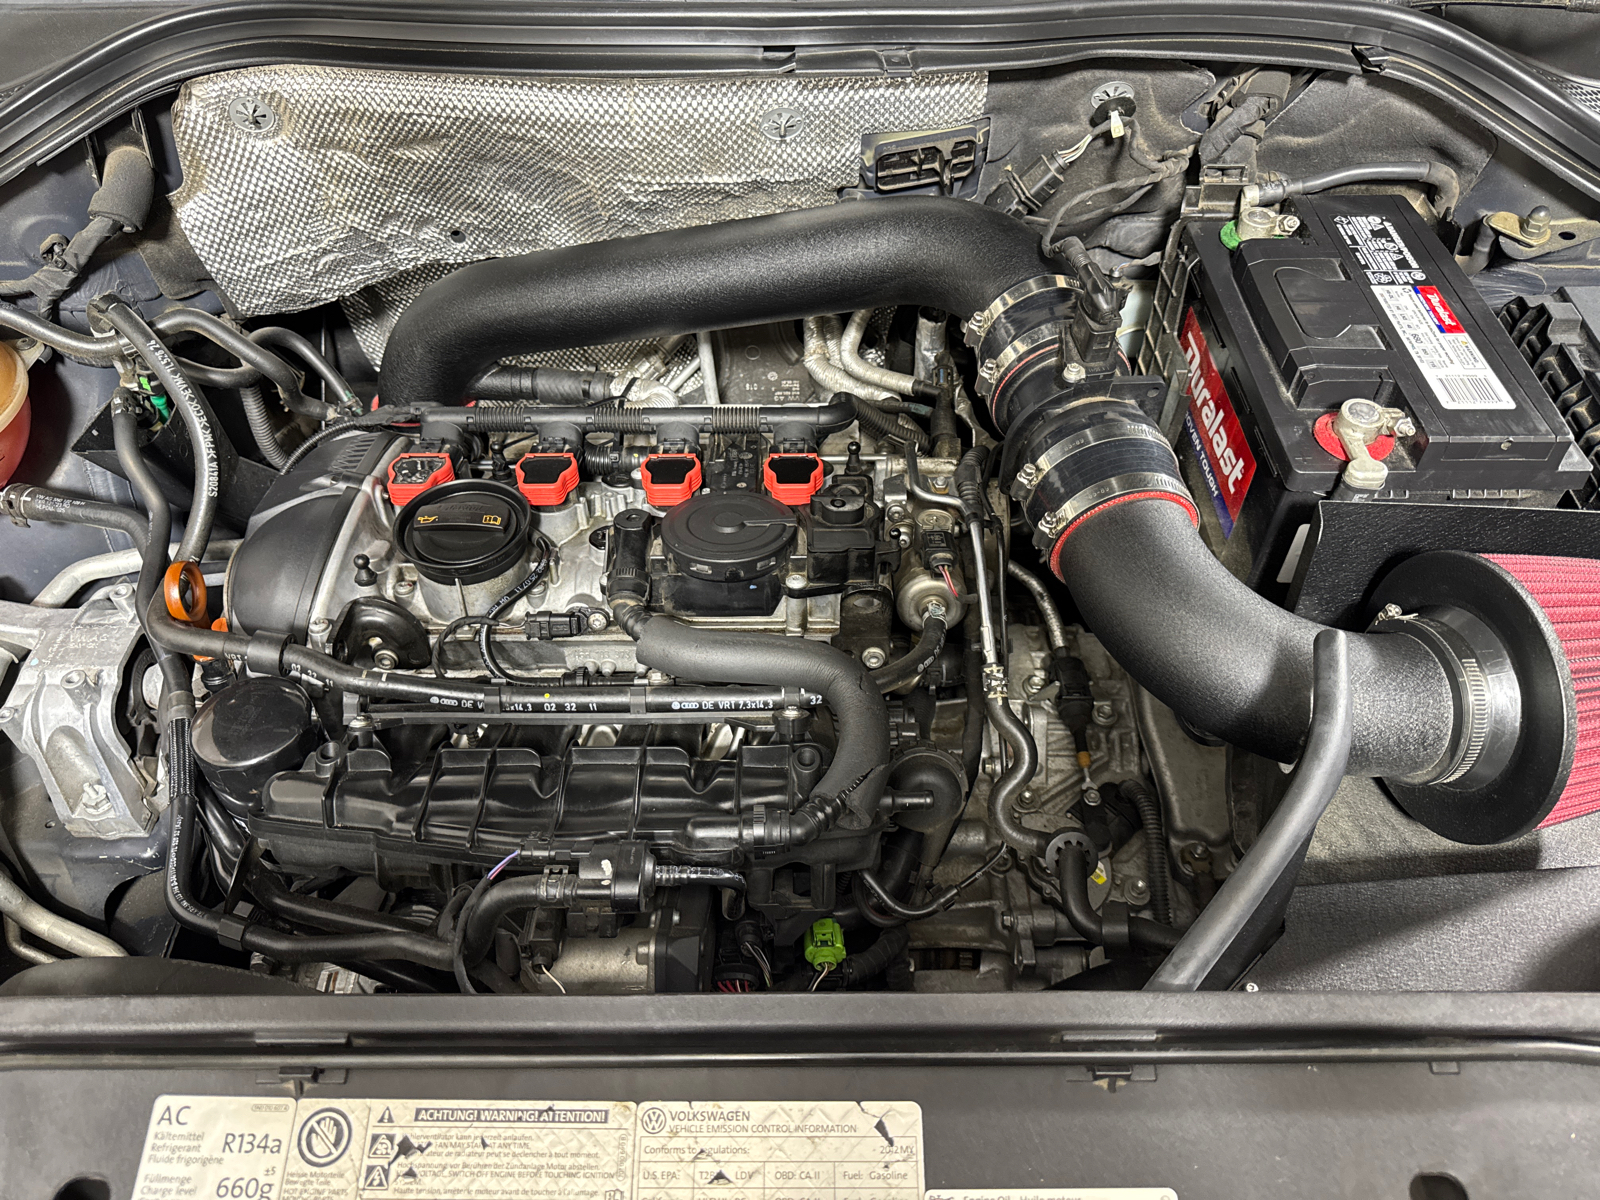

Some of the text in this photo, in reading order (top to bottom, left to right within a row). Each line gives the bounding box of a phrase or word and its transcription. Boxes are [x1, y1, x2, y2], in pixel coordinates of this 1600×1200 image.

[1426, 294, 1457, 325] Duralast
[1186, 331, 1245, 494] Duralast
[1200, 451, 1218, 497] TOUGH
[461, 700, 474, 709] DE
[810, 694, 823, 705] 32
[544, 702, 556, 712] 02
[564, 702, 576, 712] 32
[588, 702, 598, 711] 11
[702, 702, 714, 710] DE
[718, 702, 735, 710] VRT
[157, 1105, 192, 1126] AC
[418, 1110, 606, 1122] ACHTUNG! WARNING! ATTENTION!
[670, 1110, 751, 1122] VOLKSWAGEN
[669, 1124, 857, 1133] VEHICLE EMISSION CONTROL INFORMATION
[154, 1131, 205, 1142] Kältemittel
[150, 1142, 202, 1154] Refrigerant
[222, 1132, 282, 1154] R134a
[644, 1145, 750, 1156] Conforms to egulations:
[900, 1146, 914, 1154] MY
[148, 1154, 224, 1167] Fluide frigorigène
[506, 1162, 545, 1172] Zündanlage
[144, 1174, 192, 1186] Füllmenge
[643, 1171, 680, 1180] U.S. EPA:
[735, 1171, 754, 1180] LDV
[774, 1171, 820, 1180] OBD: CA II
[843, 1171, 908, 1180] Fuel: Gasoline
[140, 1186, 198, 1197] Charge level
[216, 1177, 274, 1200] 660g
